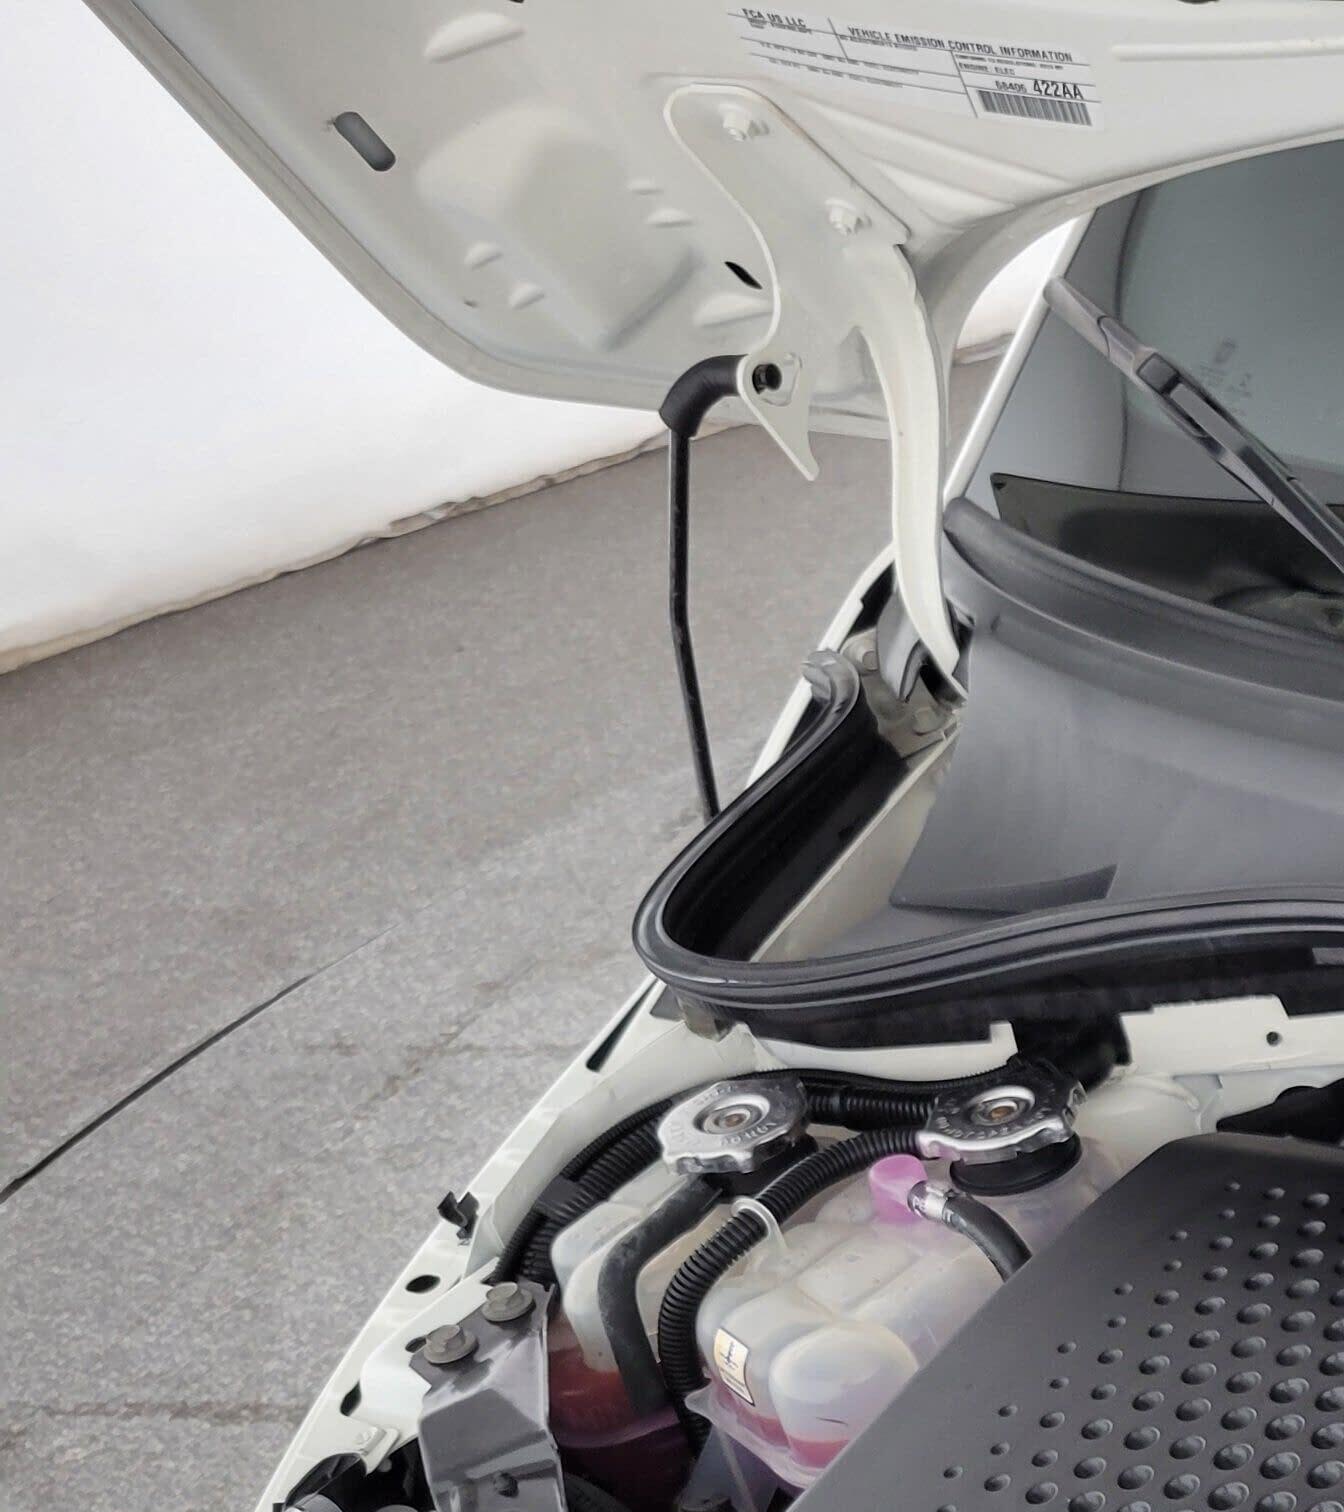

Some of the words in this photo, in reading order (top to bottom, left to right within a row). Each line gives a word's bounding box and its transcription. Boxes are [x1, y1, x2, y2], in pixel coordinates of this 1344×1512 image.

[767, 13, 785, 25] US
[786, 17, 807, 29] LLC
[847, 26, 891, 44] VEHICLE
[894, 33, 945, 50] EMISSION
[948, 39, 996, 55] CONTROL
[999, 46, 1073, 62] INFORMATION
[1032, 79, 1085, 100] 422AA
